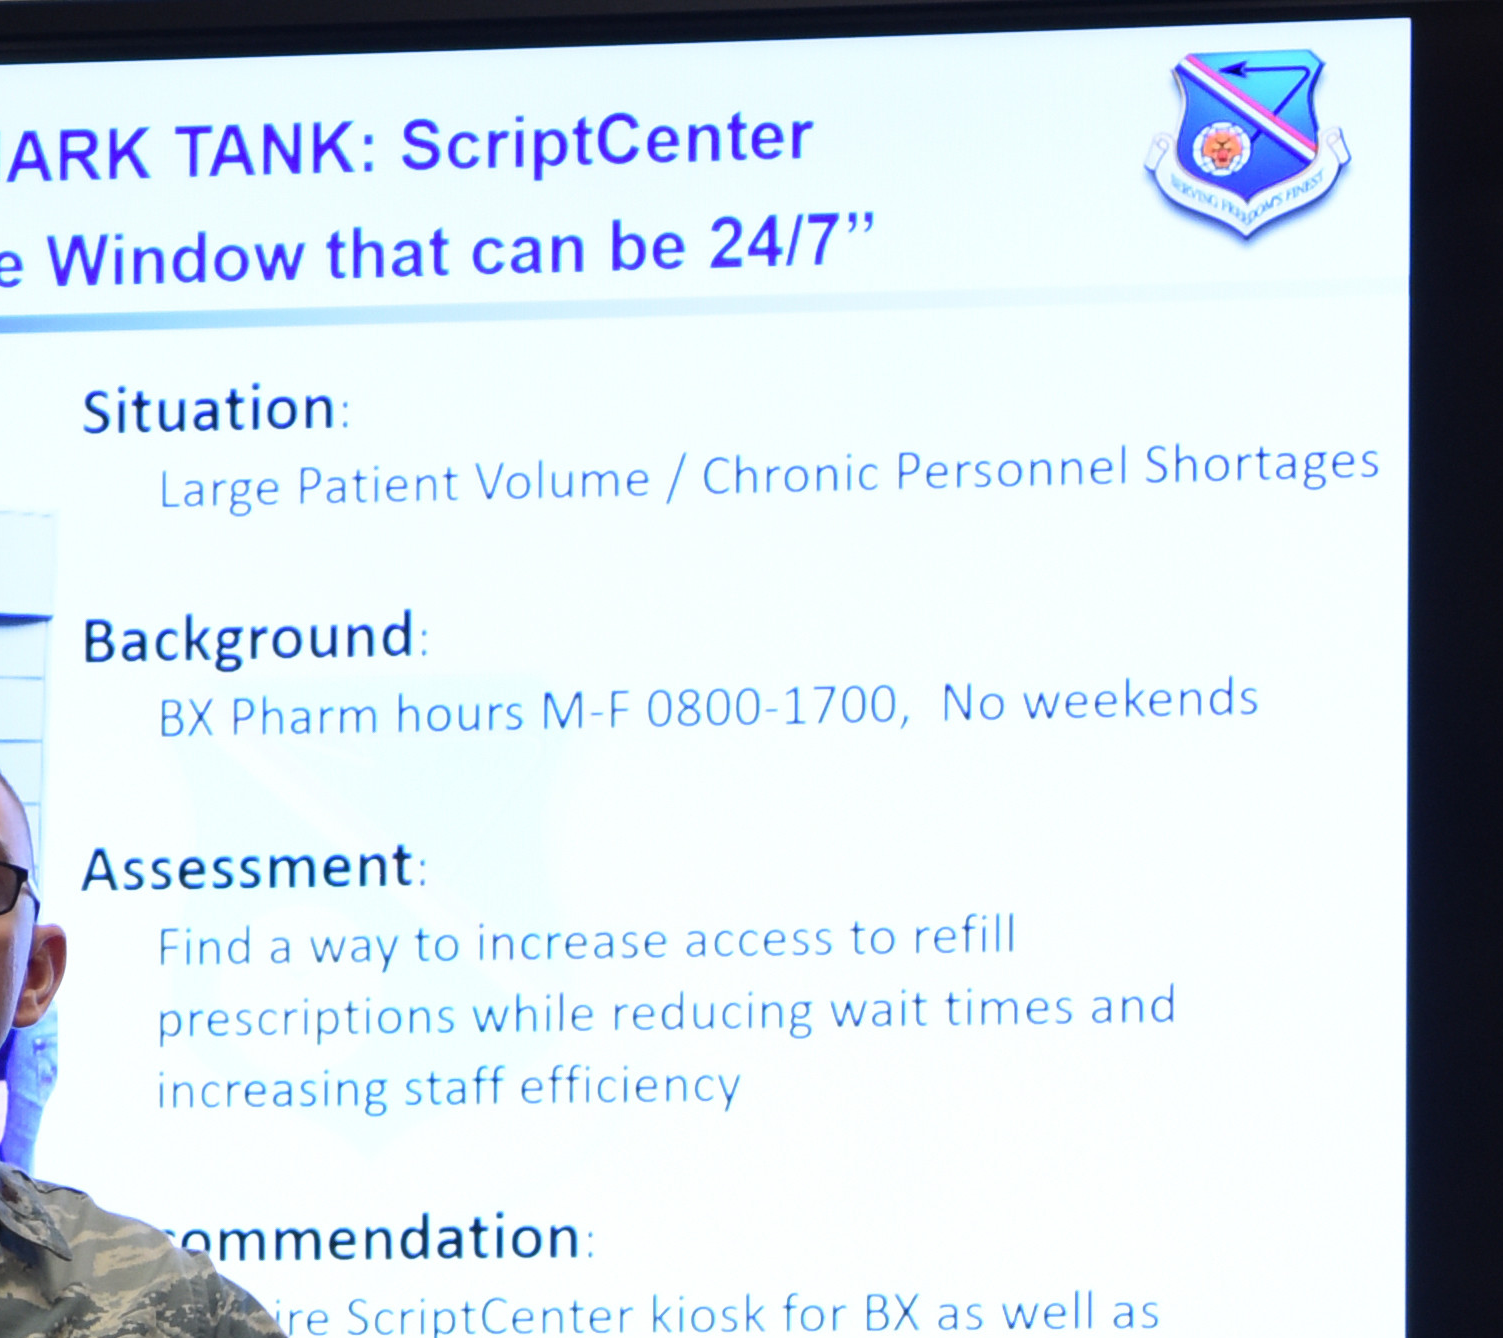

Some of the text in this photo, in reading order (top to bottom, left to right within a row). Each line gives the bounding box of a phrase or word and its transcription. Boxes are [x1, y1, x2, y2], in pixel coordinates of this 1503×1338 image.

[175, 120, 374, 177] TANK:
[402, 111, 814, 181] ScriptCenter
[1285, 168, 1324, 201] FINEST
[47, 230, 306, 287] Window
[326, 226, 450, 279] that
[472, 234, 584, 275] can
[612, 218, 686, 271] be
[710, 211, 874, 268] 24/7”
[83, 382, 348, 434] Situation:
[162, 442, 1380, 517] Large Patient Volume / Chronic Personnel Shortages
[85, 608, 428, 673] Background:
[161, 675, 1258, 737] BX Pharm hours M-F 0800-1700, No weekends
[81, 843, 426, 891] Assessment:
[161, 913, 1014, 973] Find a way to increase access to refill
[160, 983, 1174, 1047] prescriptions while reducing wait times and
[159, 1064, 741, 1117] increasing staff efficiency
[653, 1293, 765, 1333] kiosk
[783, 1292, 847, 1332] for
[867, 1293, 920, 1331] BX
[938, 1303, 984, 1331] as
[1002, 1290, 1092, 1330] well
[1113, 1302, 1159, 1329] as
